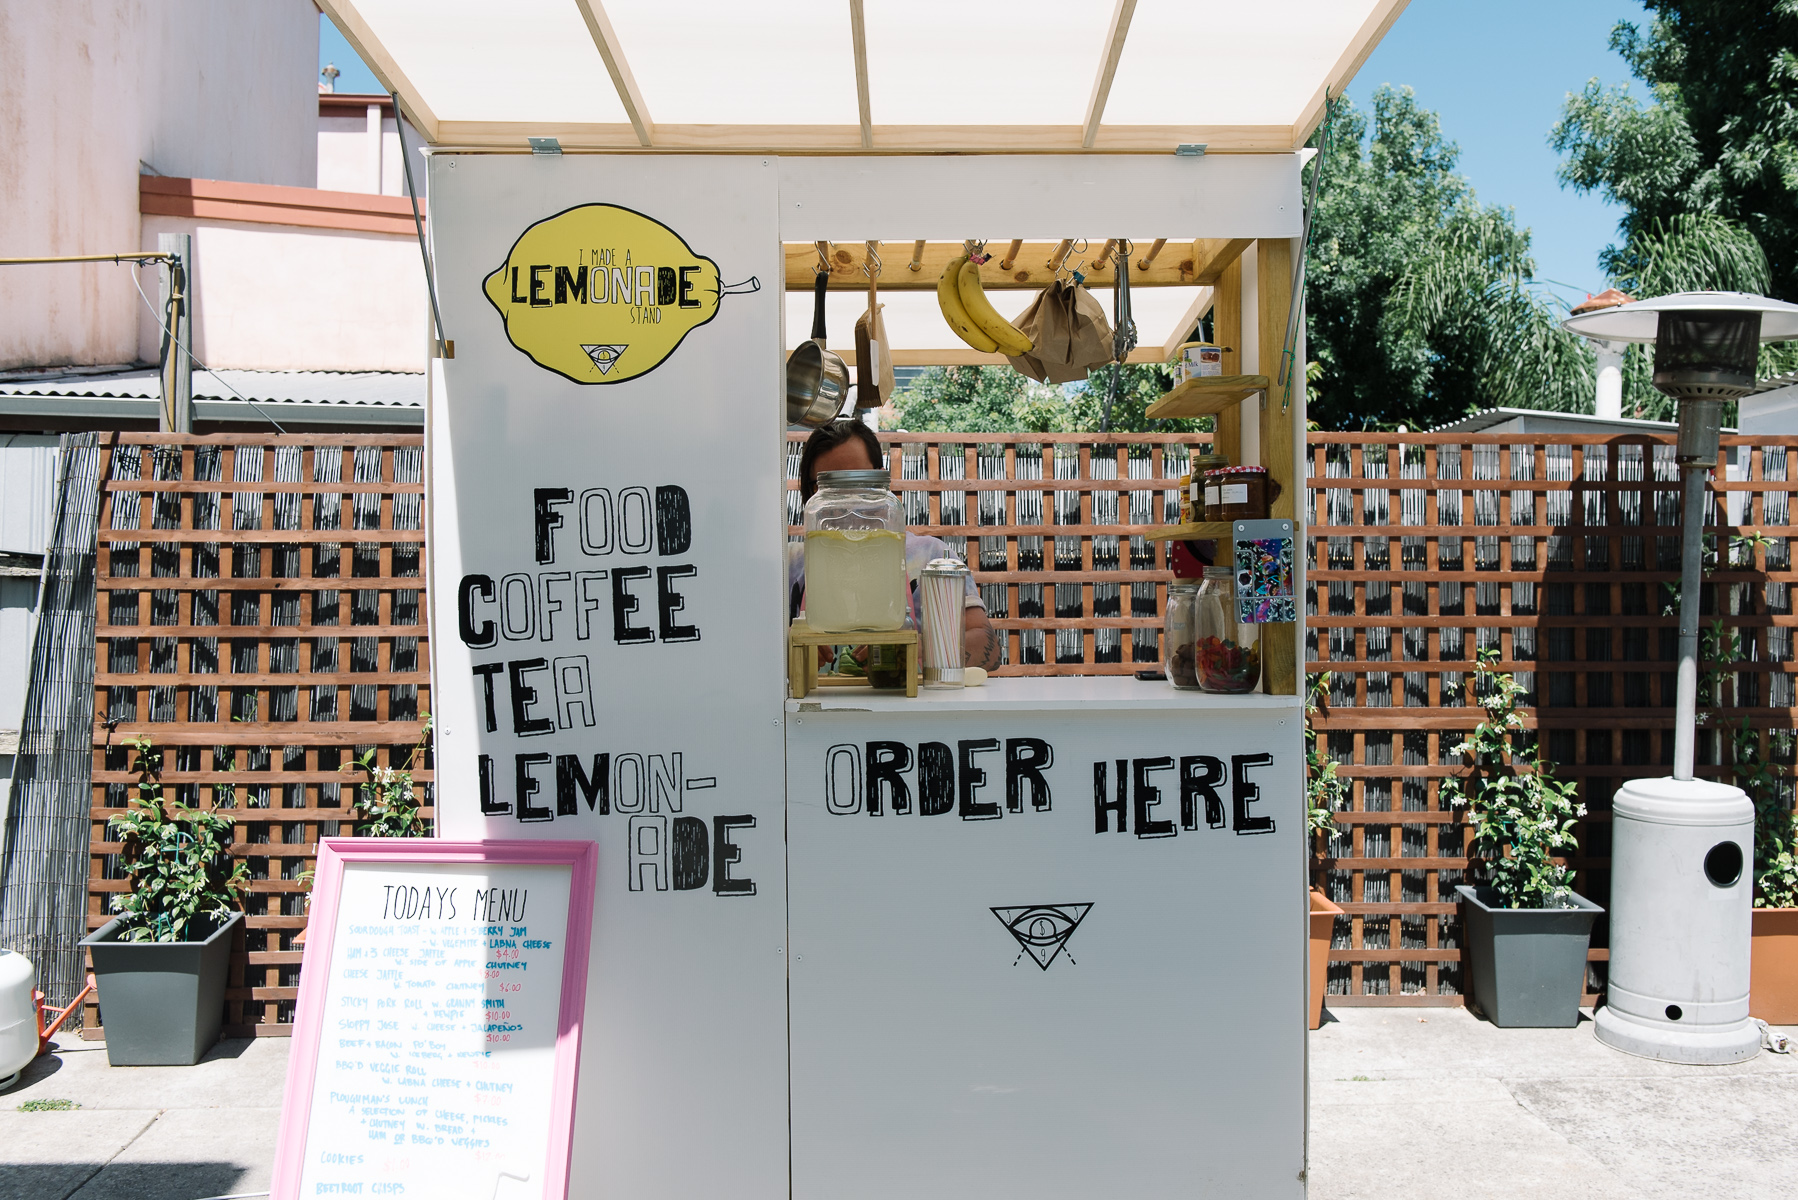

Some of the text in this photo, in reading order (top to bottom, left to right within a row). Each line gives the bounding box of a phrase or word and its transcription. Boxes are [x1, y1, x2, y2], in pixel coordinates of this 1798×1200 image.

[579, 249, 632, 266] I MADE A
[511, 265, 702, 309] LEMONADE
[630, 306, 662, 325] STAND
[534, 485, 692, 564] FOOD
[458, 564, 701, 649] COFFEE
[472, 655, 596, 737] TEA
[478, 752, 717, 823] LEMON-
[825, 737, 1276, 840] ORDER HERE
[628, 814, 757, 897] ADE
[383, 885, 528, 923] TODAYS MENU
[348, 925, 394, 936] SOURDOUGH
[399, 925, 420, 936] TOAST
[440, 925, 459, 936] APPLE
[510, 926, 527, 937] JAM
[442, 939, 479, 949] VEGEMITE
[489, 939, 517, 949] LABNA
[522, 939, 552, 950] CHEESE
[346, 947, 362, 960] HAM
[370, 947, 378, 958] 3
[383, 948, 409, 958] CHEESE
[419, 948, 445, 958] JAFFLE
[496, 948, 519, 961] $4.00
[454, 959, 478, 968] APPLE
[486, 961, 528, 971] CHUTNEY
[343, 969, 369, 979] CHEESE
[376, 969, 404, 981] JAFFLE
[405, 980, 437, 989] TOMATO
[446, 982, 485, 993] CHUTNEY
[499, 983, 521, 992] $6.00
[340, 996, 369, 1011] STICKY
[377, 998, 397, 1009] PORK
[404, 998, 422, 1010] ROLL
[446, 998, 475, 1009] GRANNY
[481, 998, 505, 1009] SMITH
[486, 1011, 511, 1021] $10.00
[427, 1023, 456, 1032] CHEESE
[339, 1039, 365, 1048] BEEF
[375, 1040, 403, 1049] BACON
[486, 1033, 511, 1043] $10.00
[370, 1063, 400, 1075] VEGGIE
[406, 1064, 427, 1076] ROLL
[398, 1077, 426, 1087] LABNA
[432, 1078, 462, 1089] CHEESE
[475, 1080, 513, 1094] CHUTNEY
[330, 1091, 391, 1105] PLOUGHMAN'S
[398, 1095, 429, 1106] LUNCH
[348, 1106, 355, 1115] A
[361, 1107, 405, 1116] SELECTION
[416, 1108, 428, 1117] OF
[473, 1115, 508, 1127] PICKLES
[369, 1119, 405, 1130] CHUTNEY
[434, 1123, 463, 1135] BREAD
[368, 1130, 386, 1140] HAM
[394, 1133, 405, 1144] OR
[451, 1137, 490, 1150] VEGGIES
[320, 1151, 365, 1166] COOKIES
[316, 1182, 405, 1196] BEETROOT CRISPS
